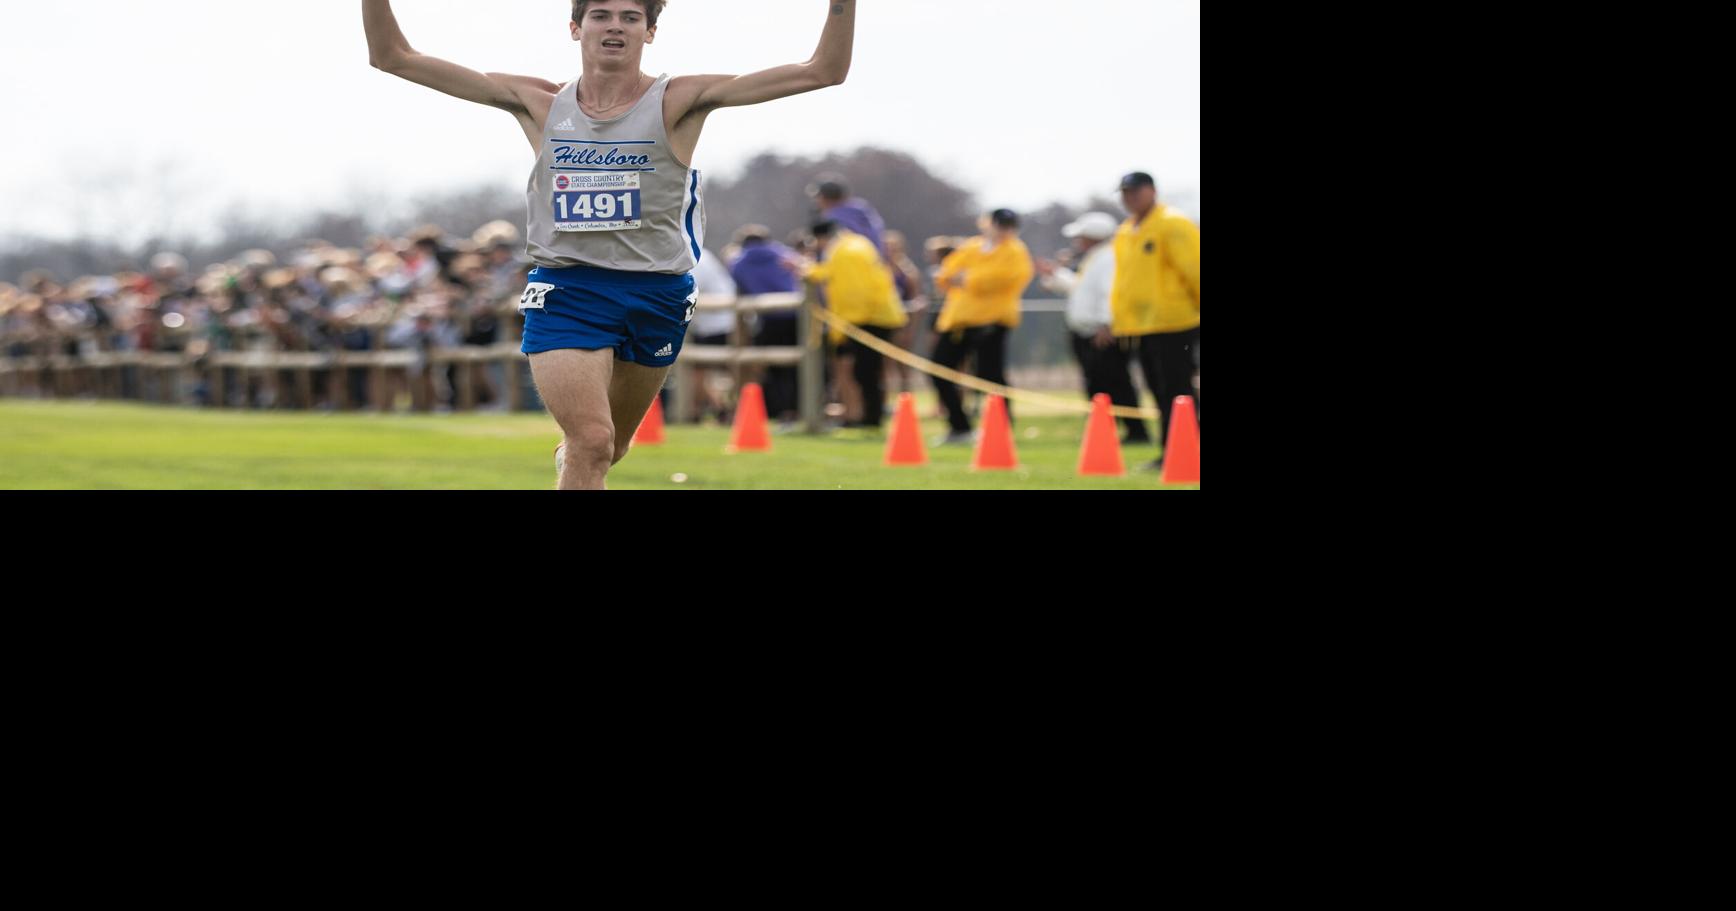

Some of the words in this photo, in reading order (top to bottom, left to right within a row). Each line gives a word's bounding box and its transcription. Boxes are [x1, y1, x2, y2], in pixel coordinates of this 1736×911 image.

[554, 146, 649, 166] Hillsboro
[571, 175, 592, 183] CROSS
[594, 174, 625, 182] COUNTRY
[556, 192, 633, 219] 1491
